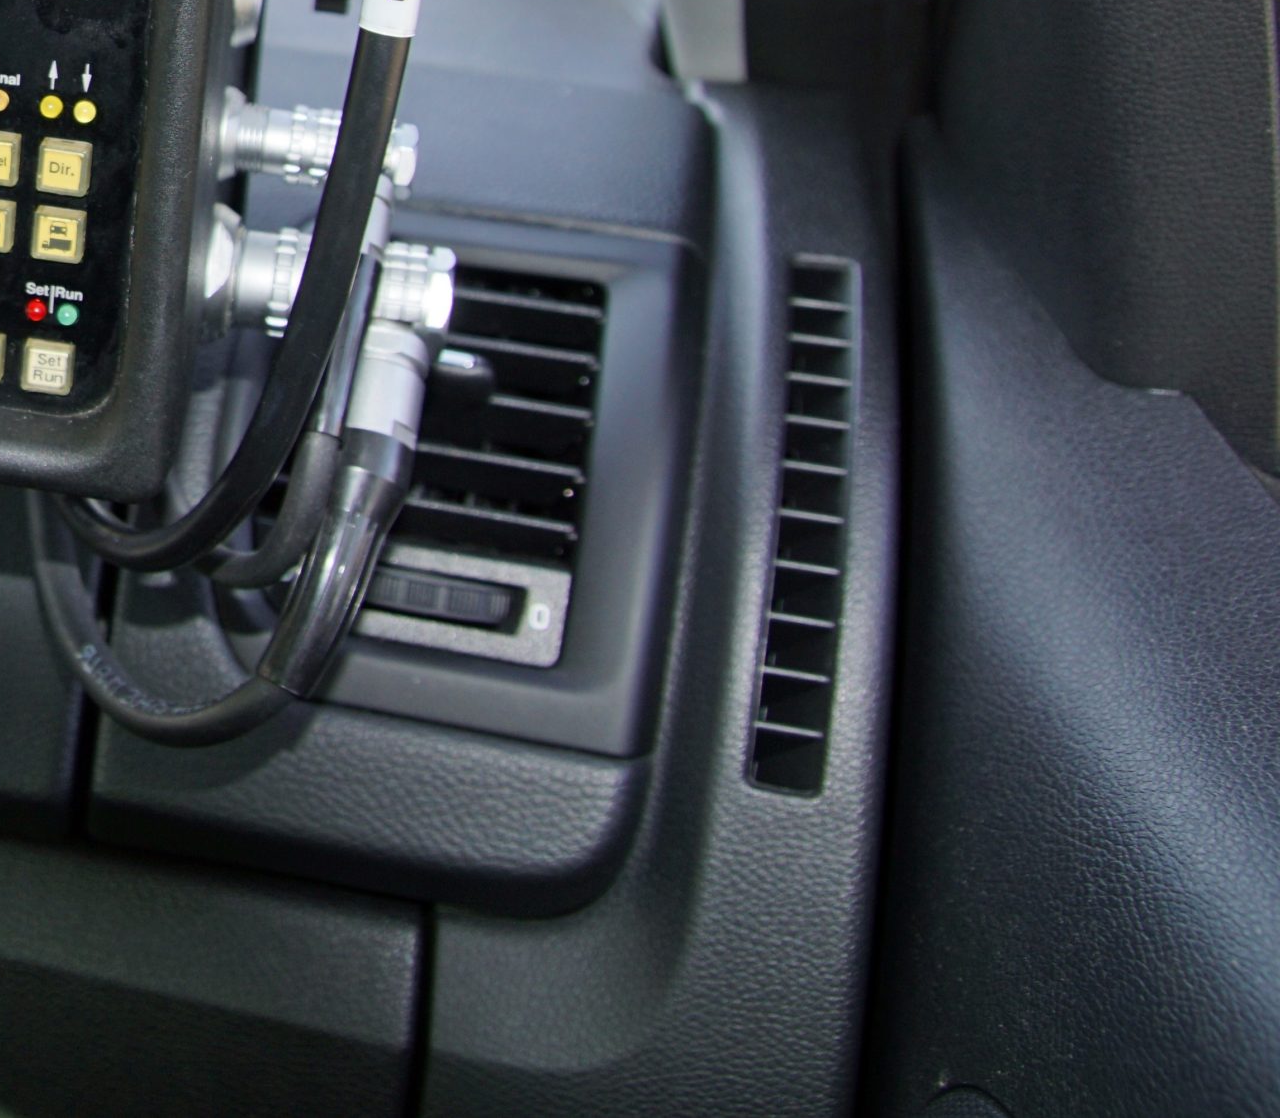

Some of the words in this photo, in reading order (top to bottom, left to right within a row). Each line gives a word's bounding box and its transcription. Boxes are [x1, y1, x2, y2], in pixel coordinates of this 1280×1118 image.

[48, 161, 75, 177] Dir.
[37, 353, 62, 366] Set
[33, 369, 64, 383] Run
